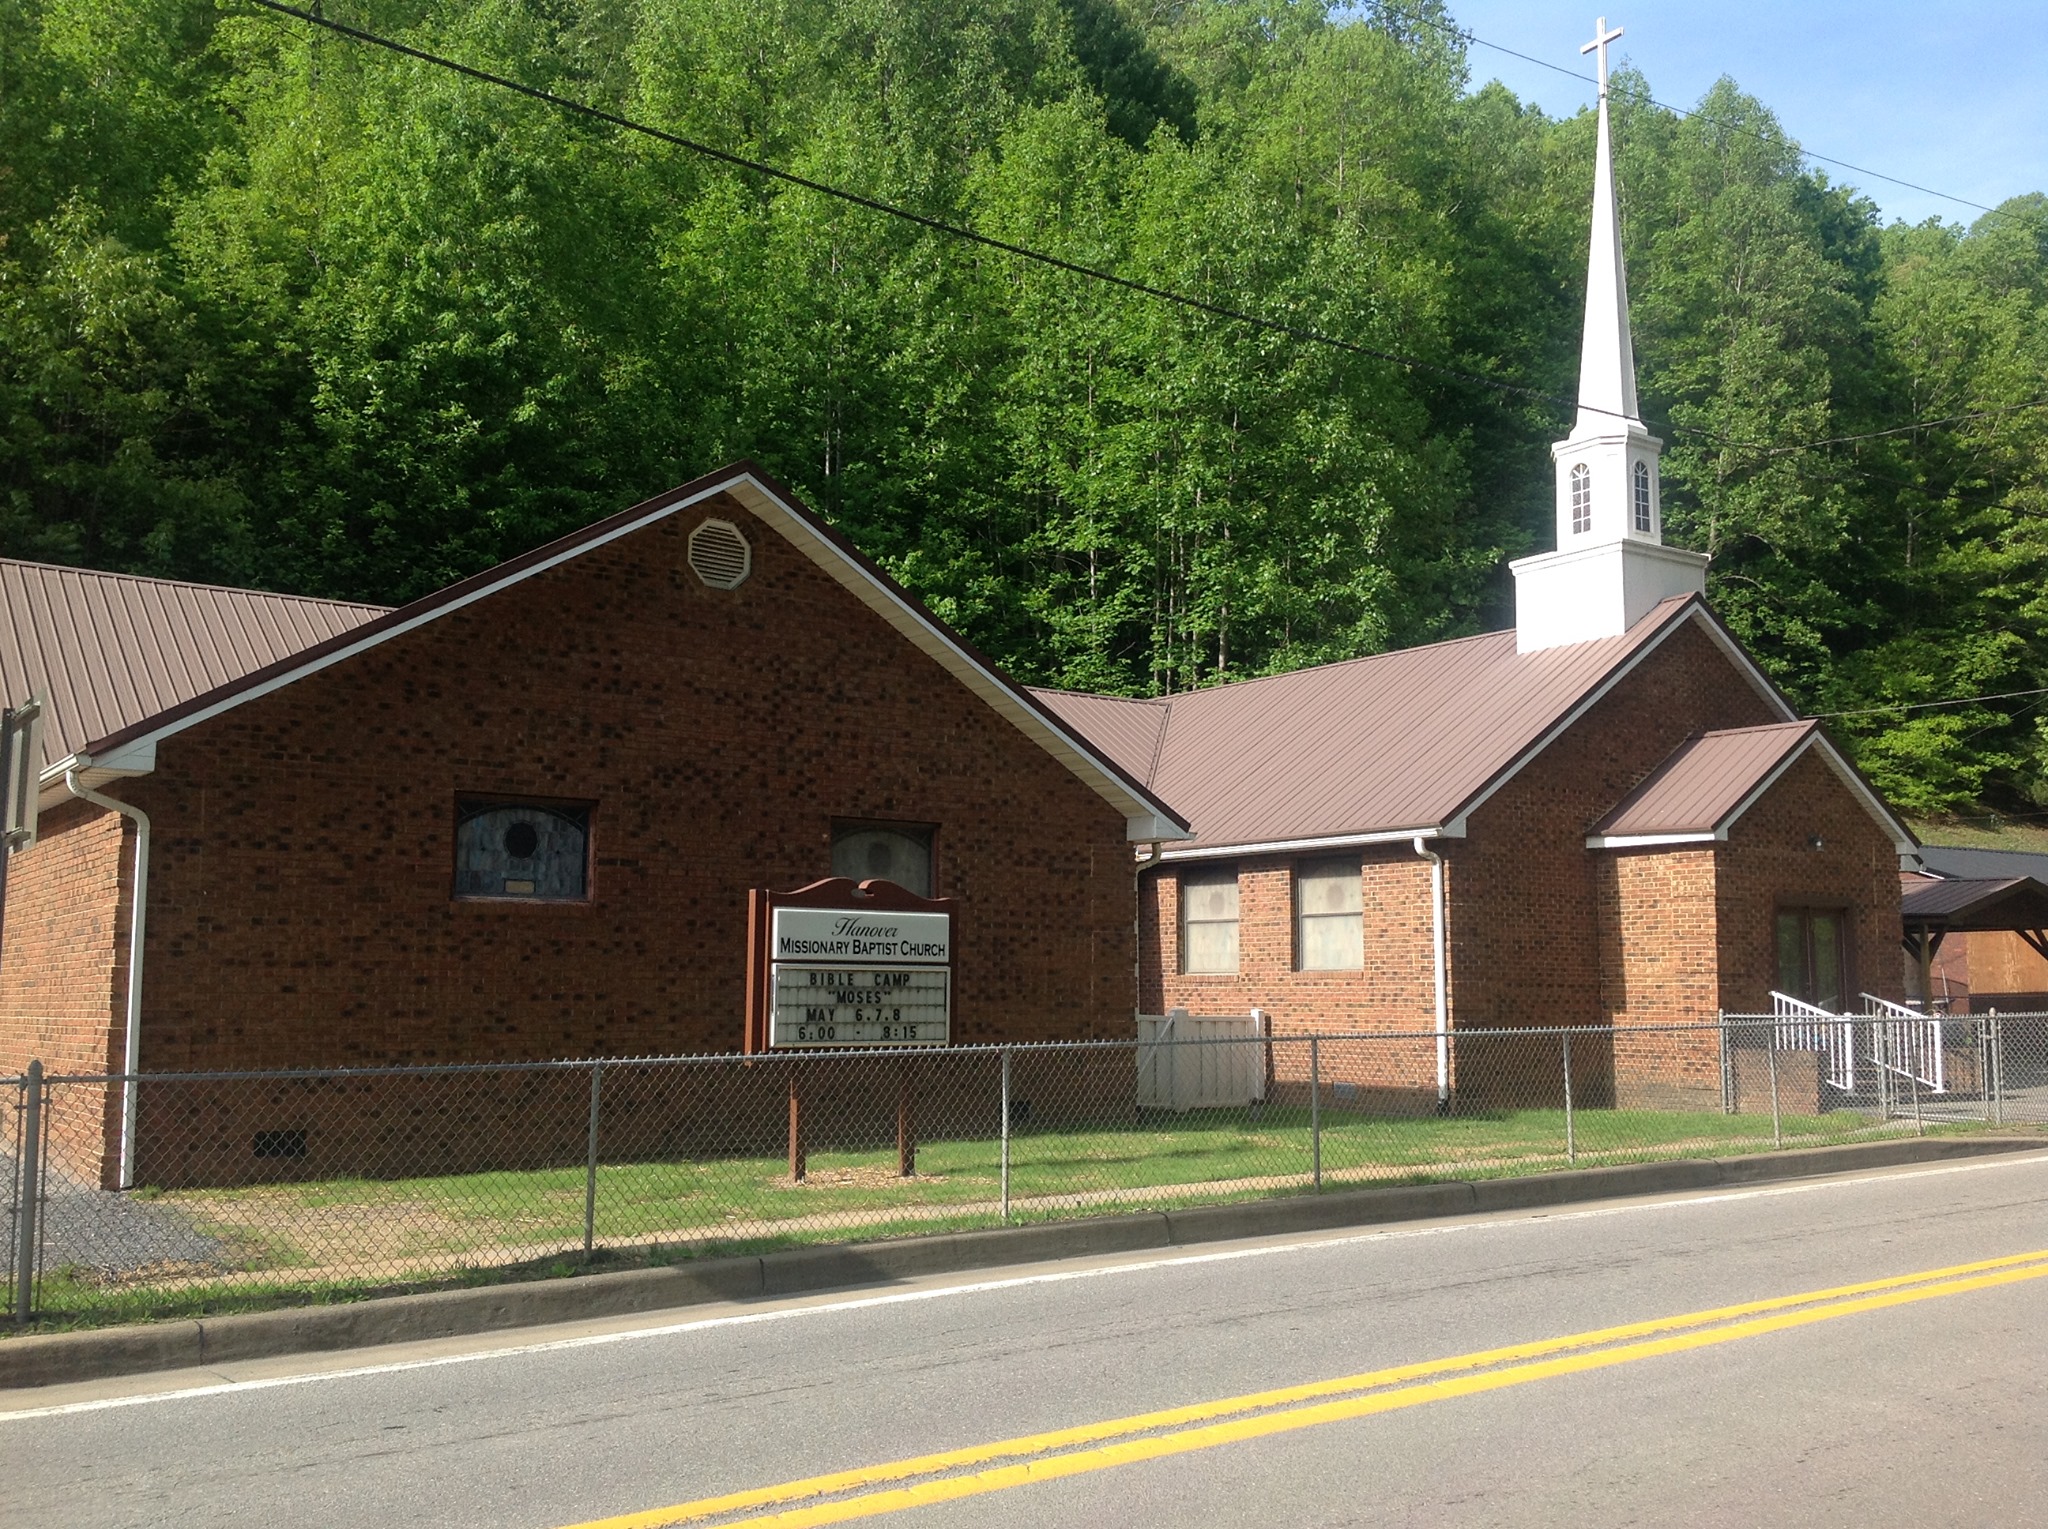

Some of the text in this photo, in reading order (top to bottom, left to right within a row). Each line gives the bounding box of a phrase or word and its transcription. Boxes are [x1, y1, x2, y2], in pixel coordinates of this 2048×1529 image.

[831, 917, 899, 938] Hanover
[780, 937, 946, 957] MISSIONARY BAPTIST CHURCH
[809, 972, 911, 987] BIBLE CAMP
[806, 1008, 835, 1022] MAY
[798, 1026, 836, 1040] 6:00
[883, 1026, 917, 1040] 8:15
